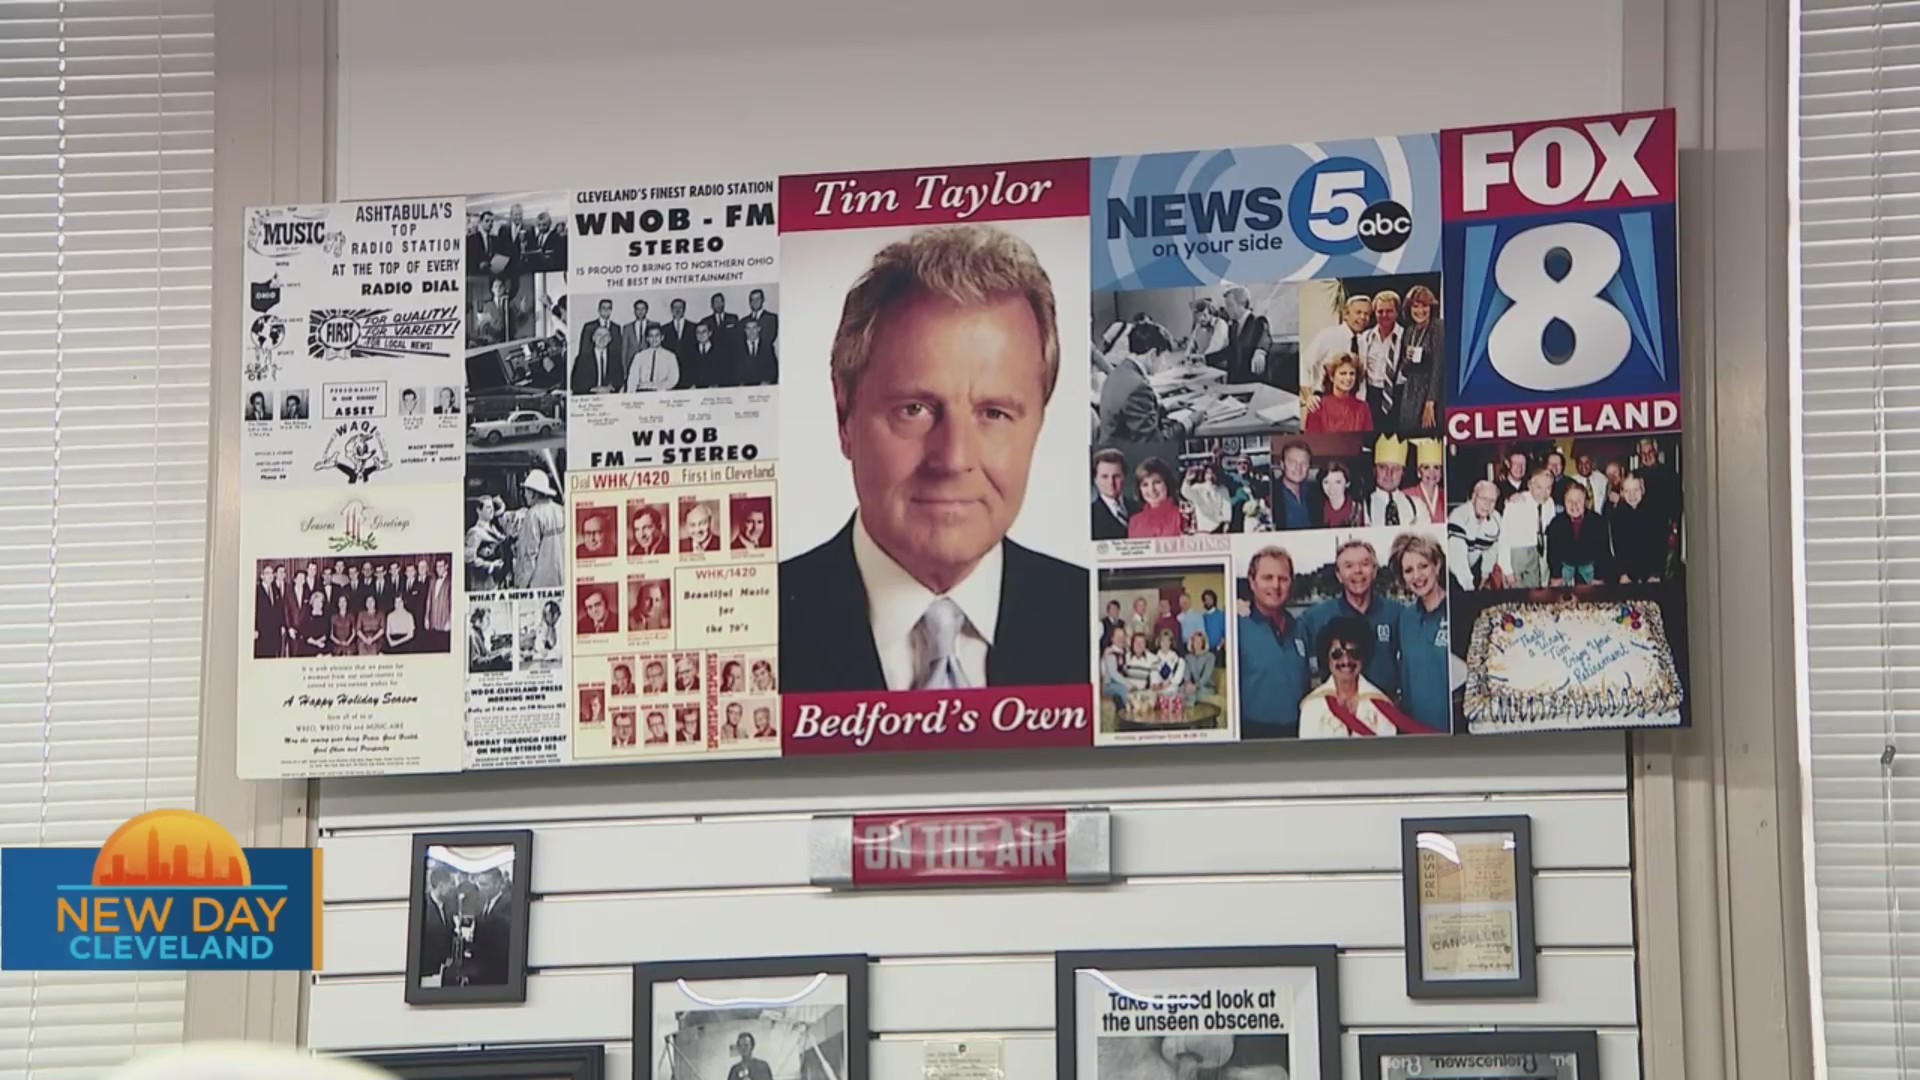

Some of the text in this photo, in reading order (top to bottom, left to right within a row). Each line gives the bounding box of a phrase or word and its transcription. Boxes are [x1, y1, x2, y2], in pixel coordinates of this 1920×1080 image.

[1462, 116, 1660, 213] FOX
[577, 181, 773, 203] CLEVELAND'S FINEST RADIO STATION
[814, 171, 1052, 219] Tim Taylor
[356, 202, 452, 222] ASHTABULA'S
[1107, 170, 1411, 242] NEWS 5 abc
[576, 203, 775, 235] WNOB FM
[264, 222, 325, 245] MUSIC
[392, 224, 417, 237] TOP
[351, 238, 460, 255] RADIO STATION
[629, 236, 724, 257] STEREO
[1152, 233, 1283, 262] on your side
[332, 259, 459, 276] AT THE TOP OF EVERY
[576, 256, 774, 276] IS PROUD TO BRING TO NORTHERN OHIO
[361, 279, 459, 296] RADIO DIAL
[607, 272, 743, 287] THE BEST IN ENTERTAINMENT
[364, 305, 457, 325] FOR QUALITY!
[1487, 221, 1632, 391] 8
[326, 323, 353, 343] FIRST
[364, 320, 461, 336] FOR VARIETY!
[384, 340, 406, 349] LOCAL
[335, 406, 374, 416] ASSET
[1447, 400, 1678, 441] CLEVELAND
[632, 427, 718, 446] WNOB
[591, 444, 758, 467] FM STEREO
[593, 471, 669, 489] WHK/1420
[682, 469, 707, 482] First
[711, 468, 721, 481] in
[725, 465, 775, 481] Cleveland
[695, 567, 756, 580] WHK/1420
[468, 589, 565, 602] WHAT A NEWS TEAM!
[684, 588, 769, 599] Beautiful Music
[719, 606, 734, 616] for
[706, 624, 722, 633] the
[283, 692, 418, 708] A Happy Holiday Season
[487, 695, 523, 703] MORNING
[792, 697, 1088, 747] Bedford's Own
[467, 738, 500, 747] MONDAY
[503, 736, 539, 745] THROUGH
[477, 747, 488, 755] ON
[515, 744, 542, 752] STEREO
[864, 821, 1057, 869] ON THE AIR
[1424, 853, 1435, 898] PRESS
[1109, 992, 1149, 1011] Take
[1168, 990, 1212, 1014] good
[1216, 990, 1254, 1009] look
[1258, 990, 1276, 1008] at
[1102, 1010, 1284, 1032] the unseen obscene.
